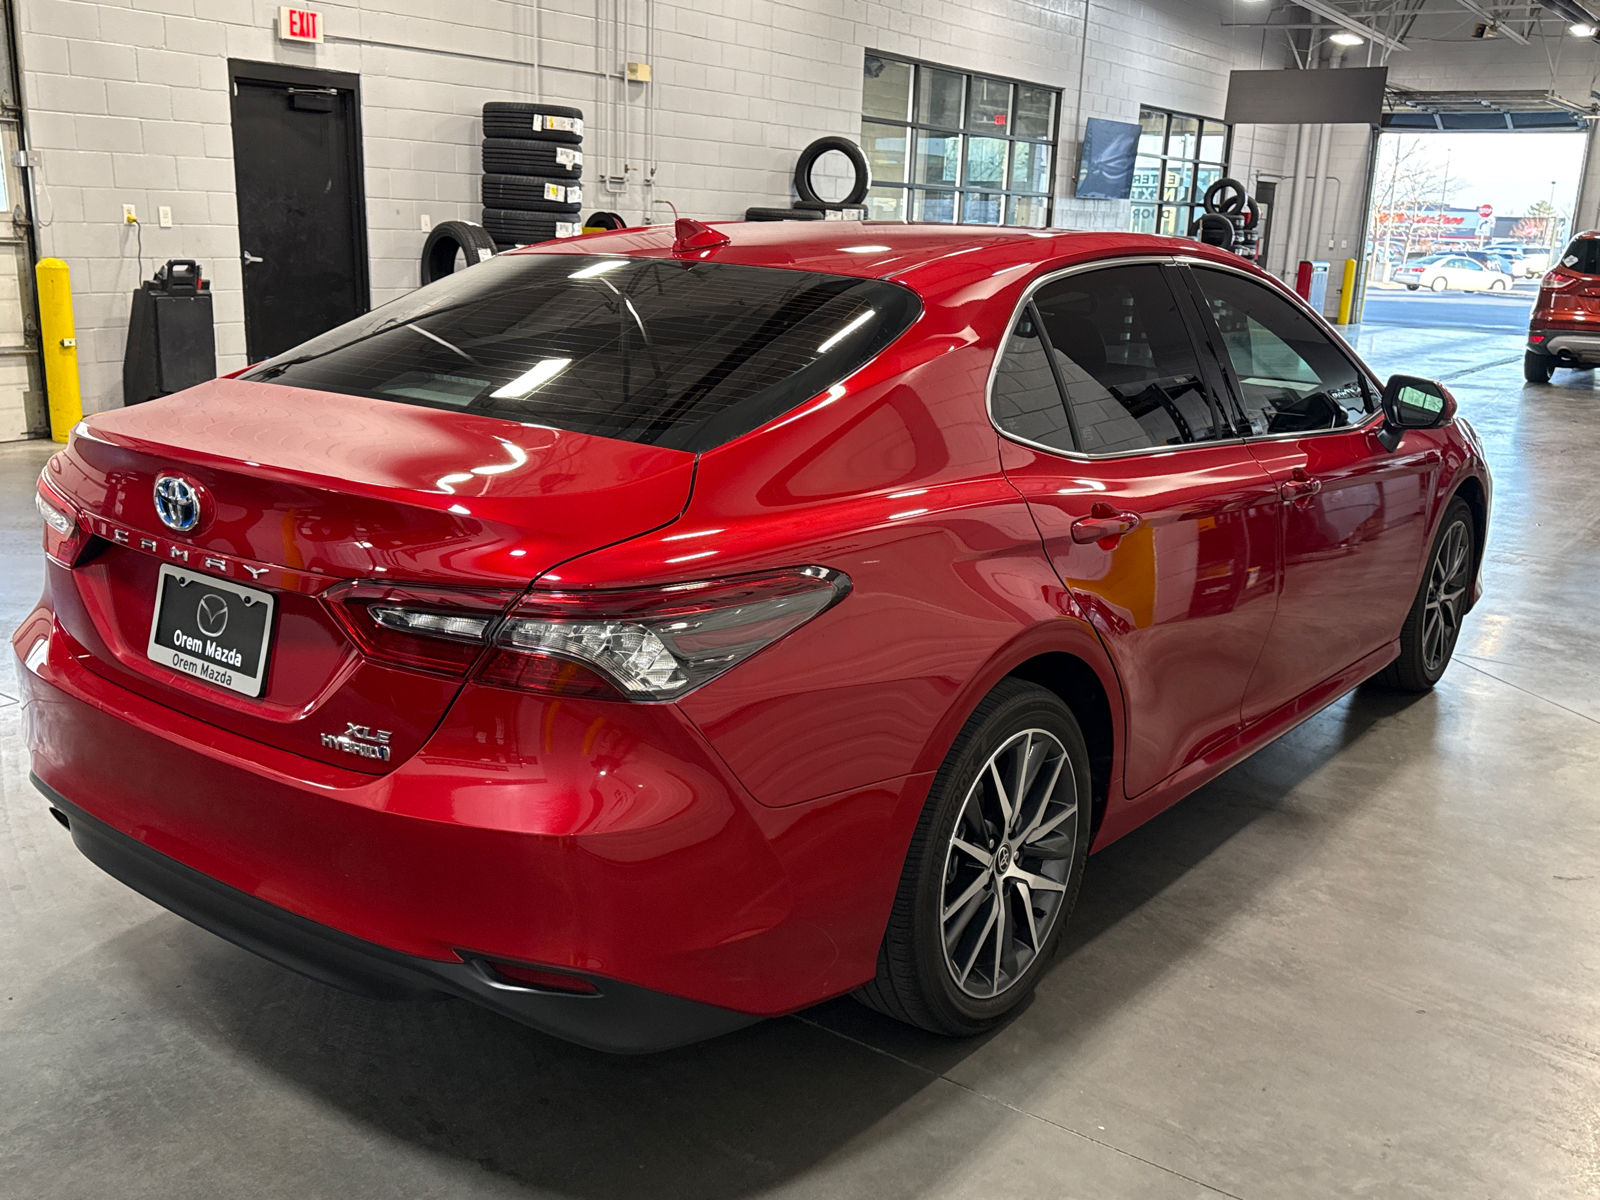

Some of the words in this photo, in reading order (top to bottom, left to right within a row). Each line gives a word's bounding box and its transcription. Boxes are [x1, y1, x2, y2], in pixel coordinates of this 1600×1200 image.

[289, 9, 317, 39] EXIT
[114, 528, 269, 579] CAMRY
[173, 629, 203, 654] Orem
[205, 639, 242, 667] Mazda
[172, 653, 198, 674] Orem
[200, 662, 232, 686] Mazda
[320, 732, 382, 759] HYBRID
[344, 722, 392, 744] XLE
